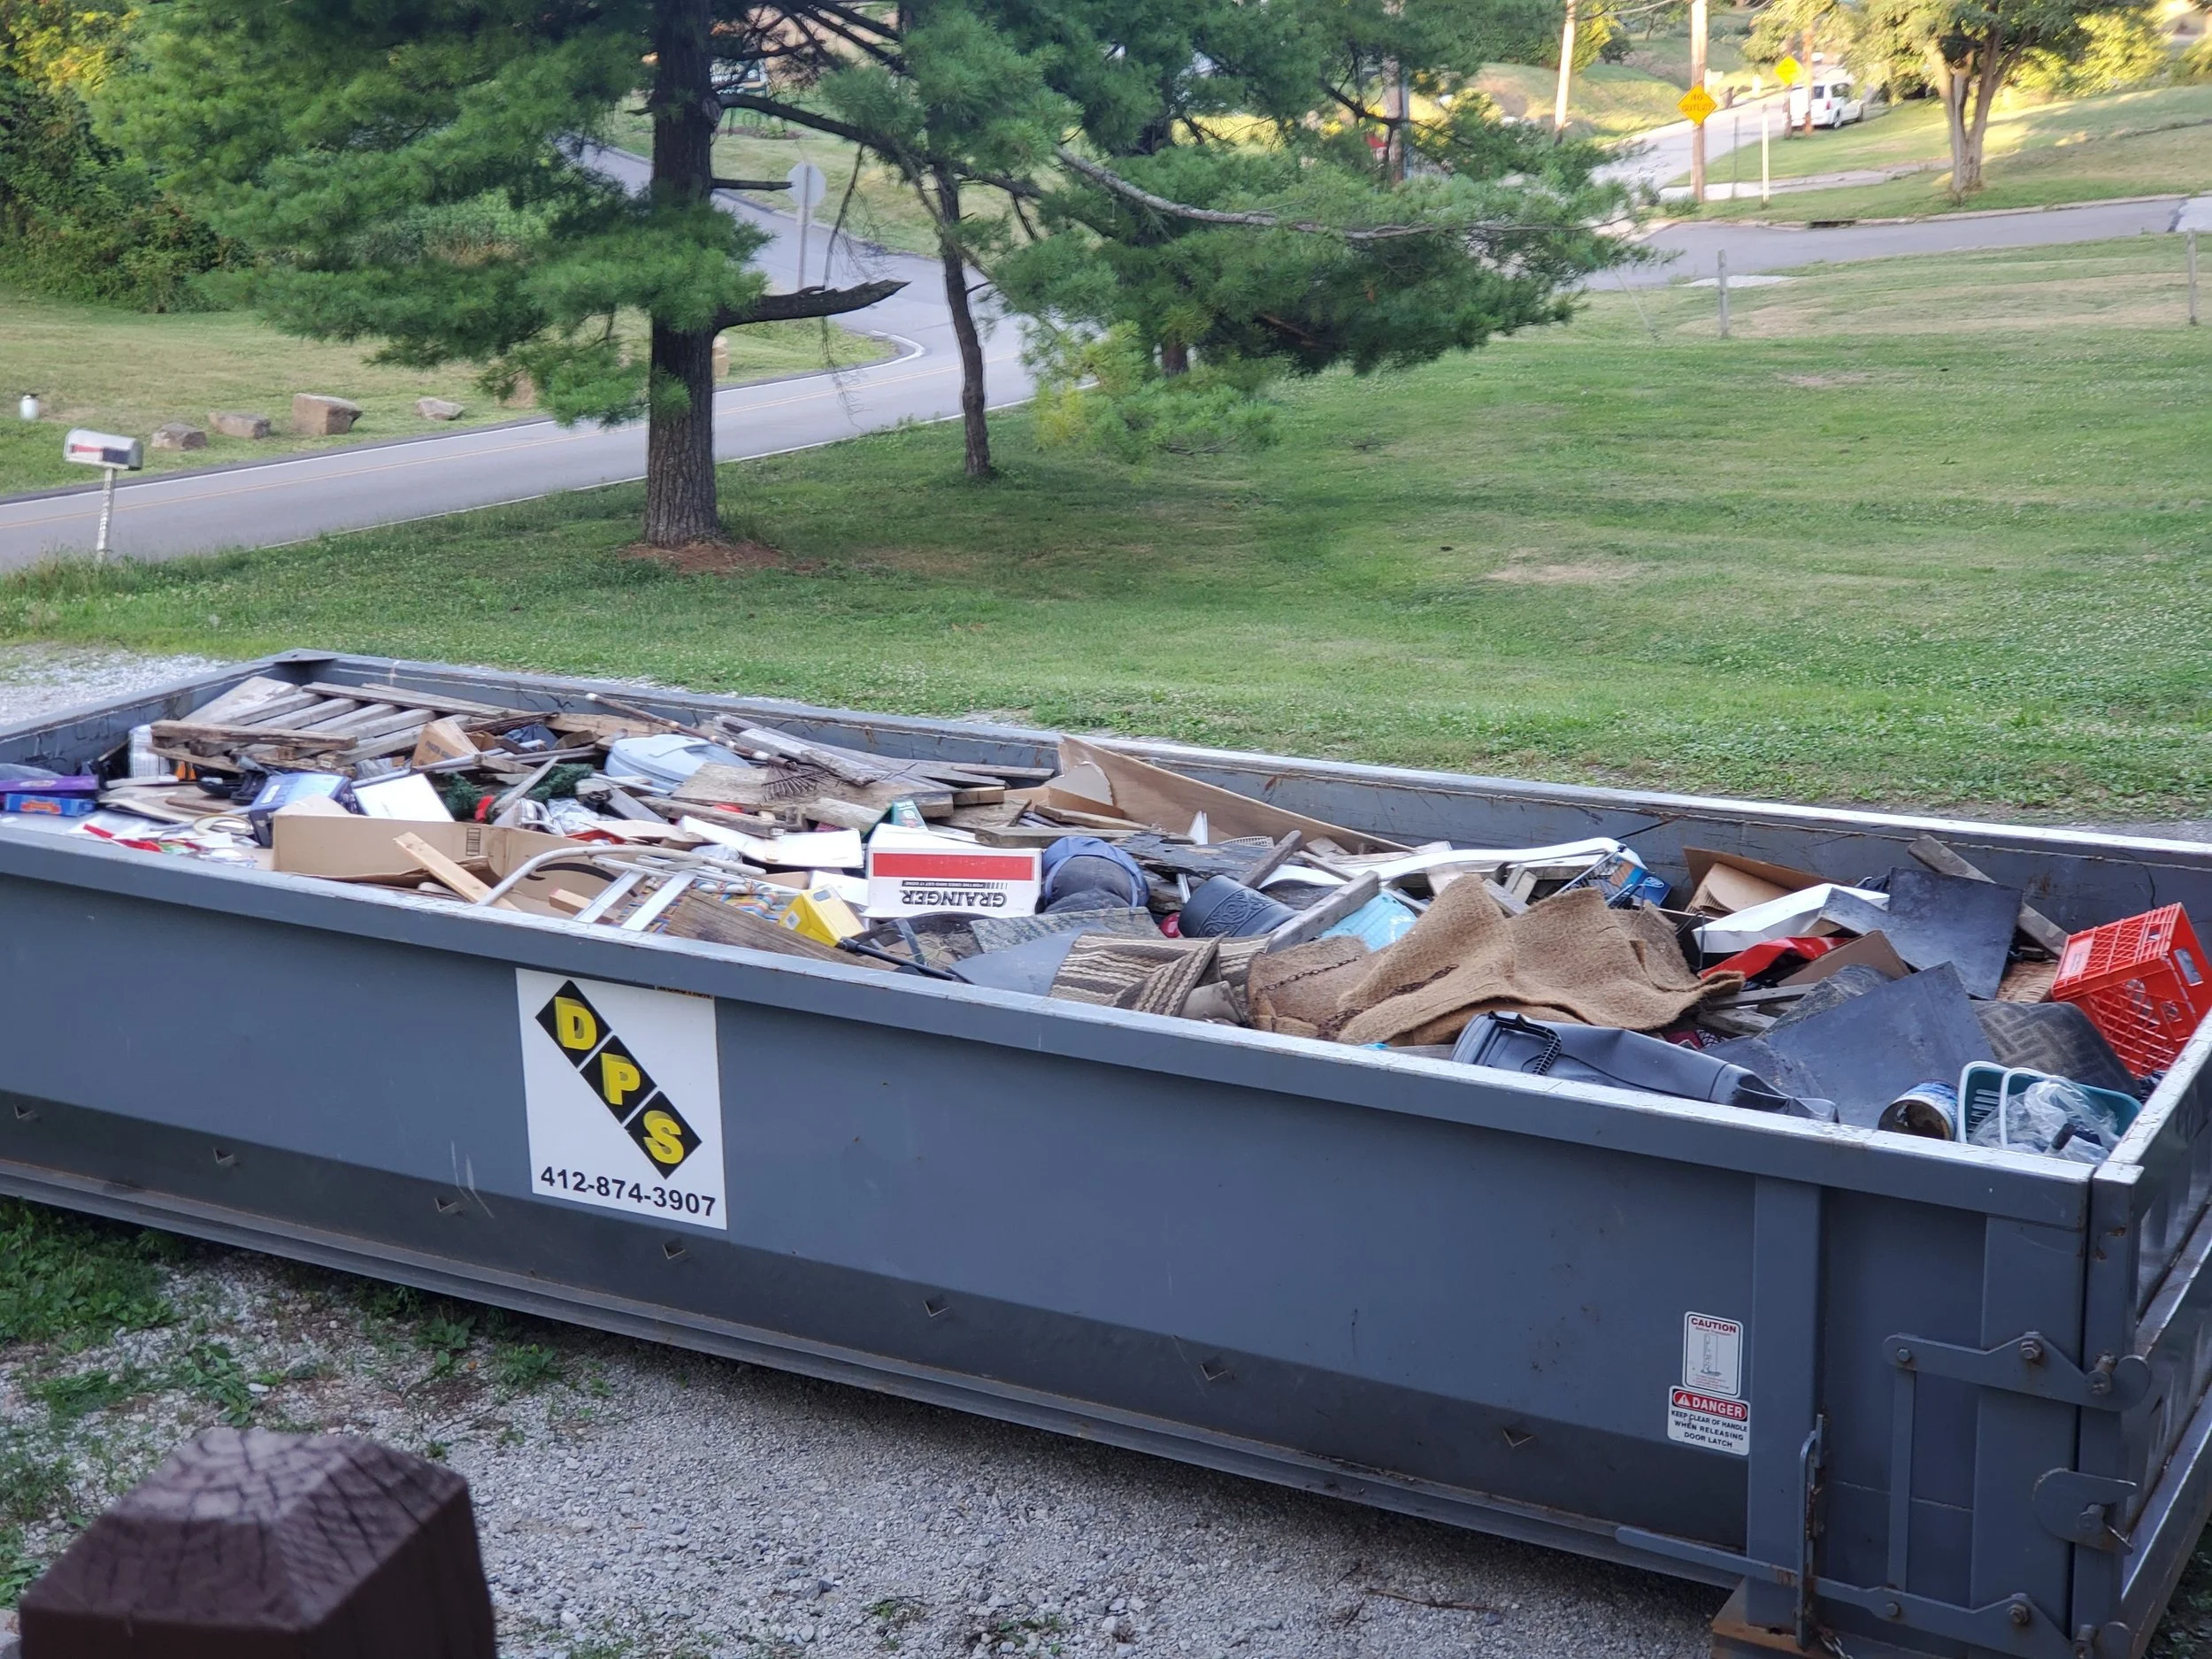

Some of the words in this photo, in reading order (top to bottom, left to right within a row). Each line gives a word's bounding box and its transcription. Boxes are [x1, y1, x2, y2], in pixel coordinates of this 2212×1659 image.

[902, 890, 1008, 907] GRAINGER
[540, 1165, 716, 1217] 412-874-3907
[1691, 1317, 1737, 1333] CAUTION
[1692, 1396, 1742, 1418] DANGER
[1671, 1410, 1688, 1422] KEEP
[1689, 1414, 1710, 1425] CLEAR
[1722, 1421, 1747, 1432] HANDLE
[1674, 1419, 1697, 1431] WHEN
[1699, 1425, 1744, 1440] RELEASING
[1684, 1432, 1706, 1441] DOOR
[1708, 1437, 1732, 1448] LATCH
